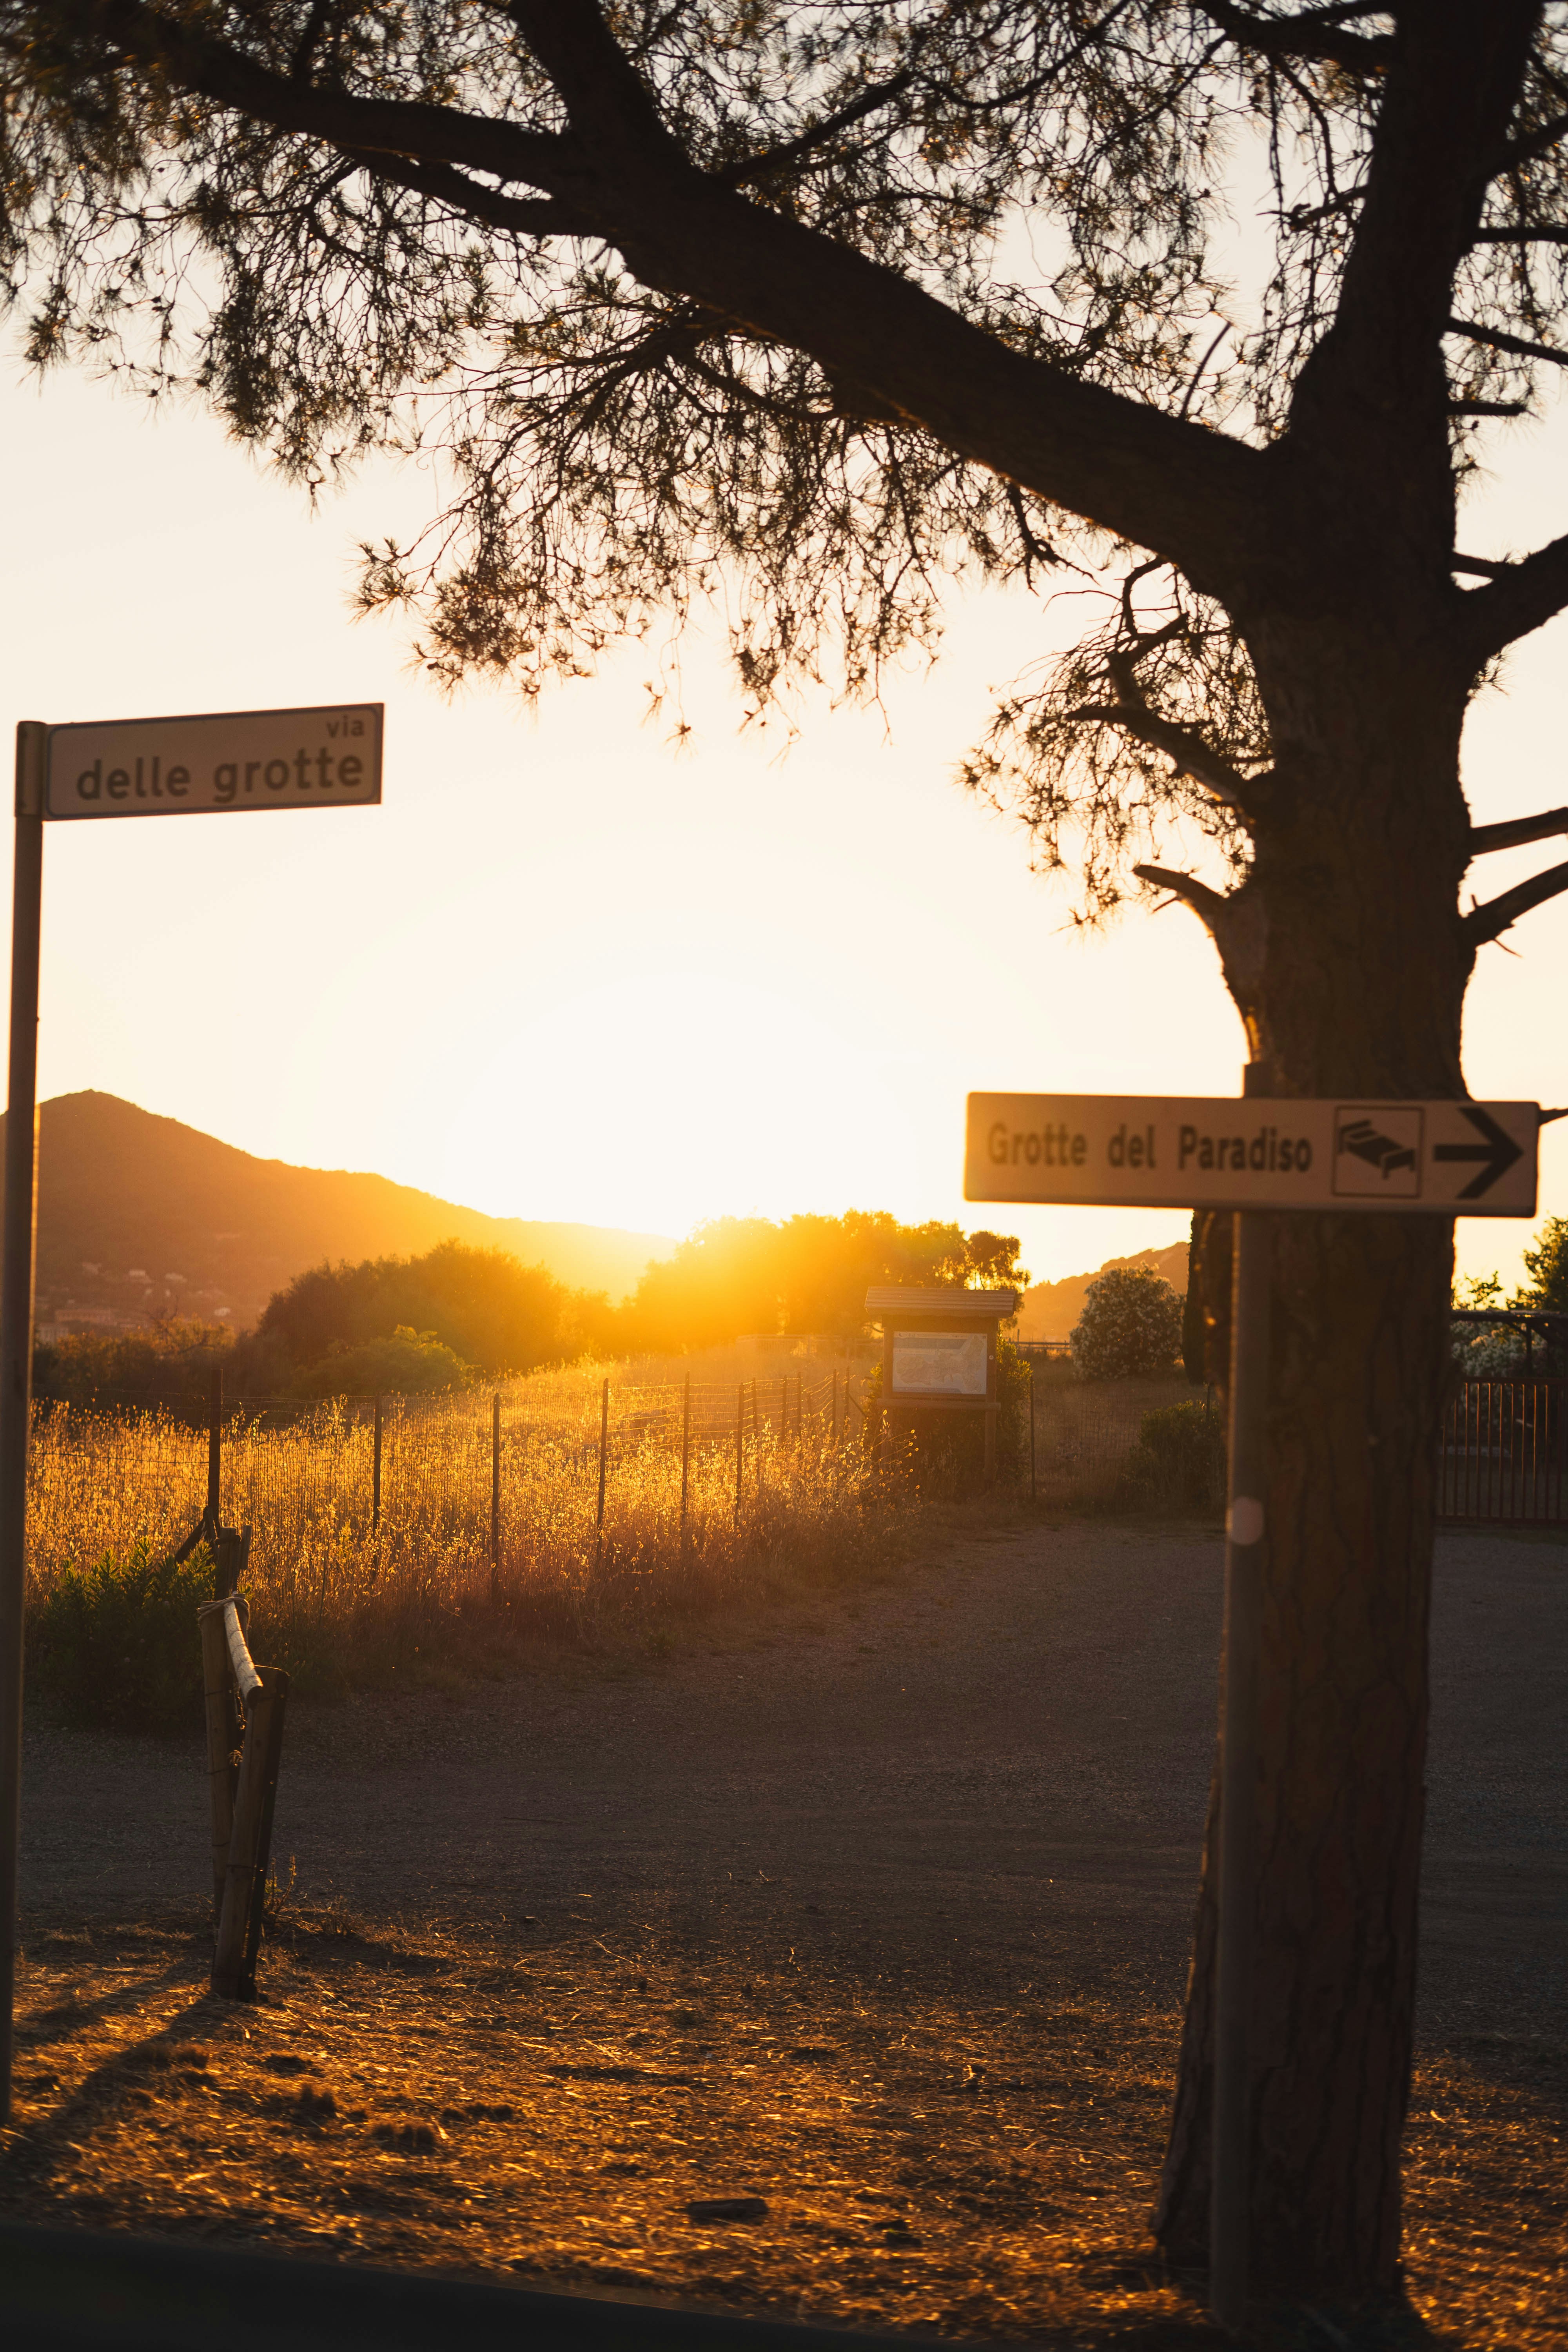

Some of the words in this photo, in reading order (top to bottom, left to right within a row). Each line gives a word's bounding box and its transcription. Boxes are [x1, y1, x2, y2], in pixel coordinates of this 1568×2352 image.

[326, 715, 365, 738] via
[78, 757, 191, 801] delle
[213, 748, 363, 804] grotte
[987, 1123, 1087, 1167] Grotte
[1108, 1125, 1156, 1169] del
[1178, 1125, 1312, 1173] Paradiso
